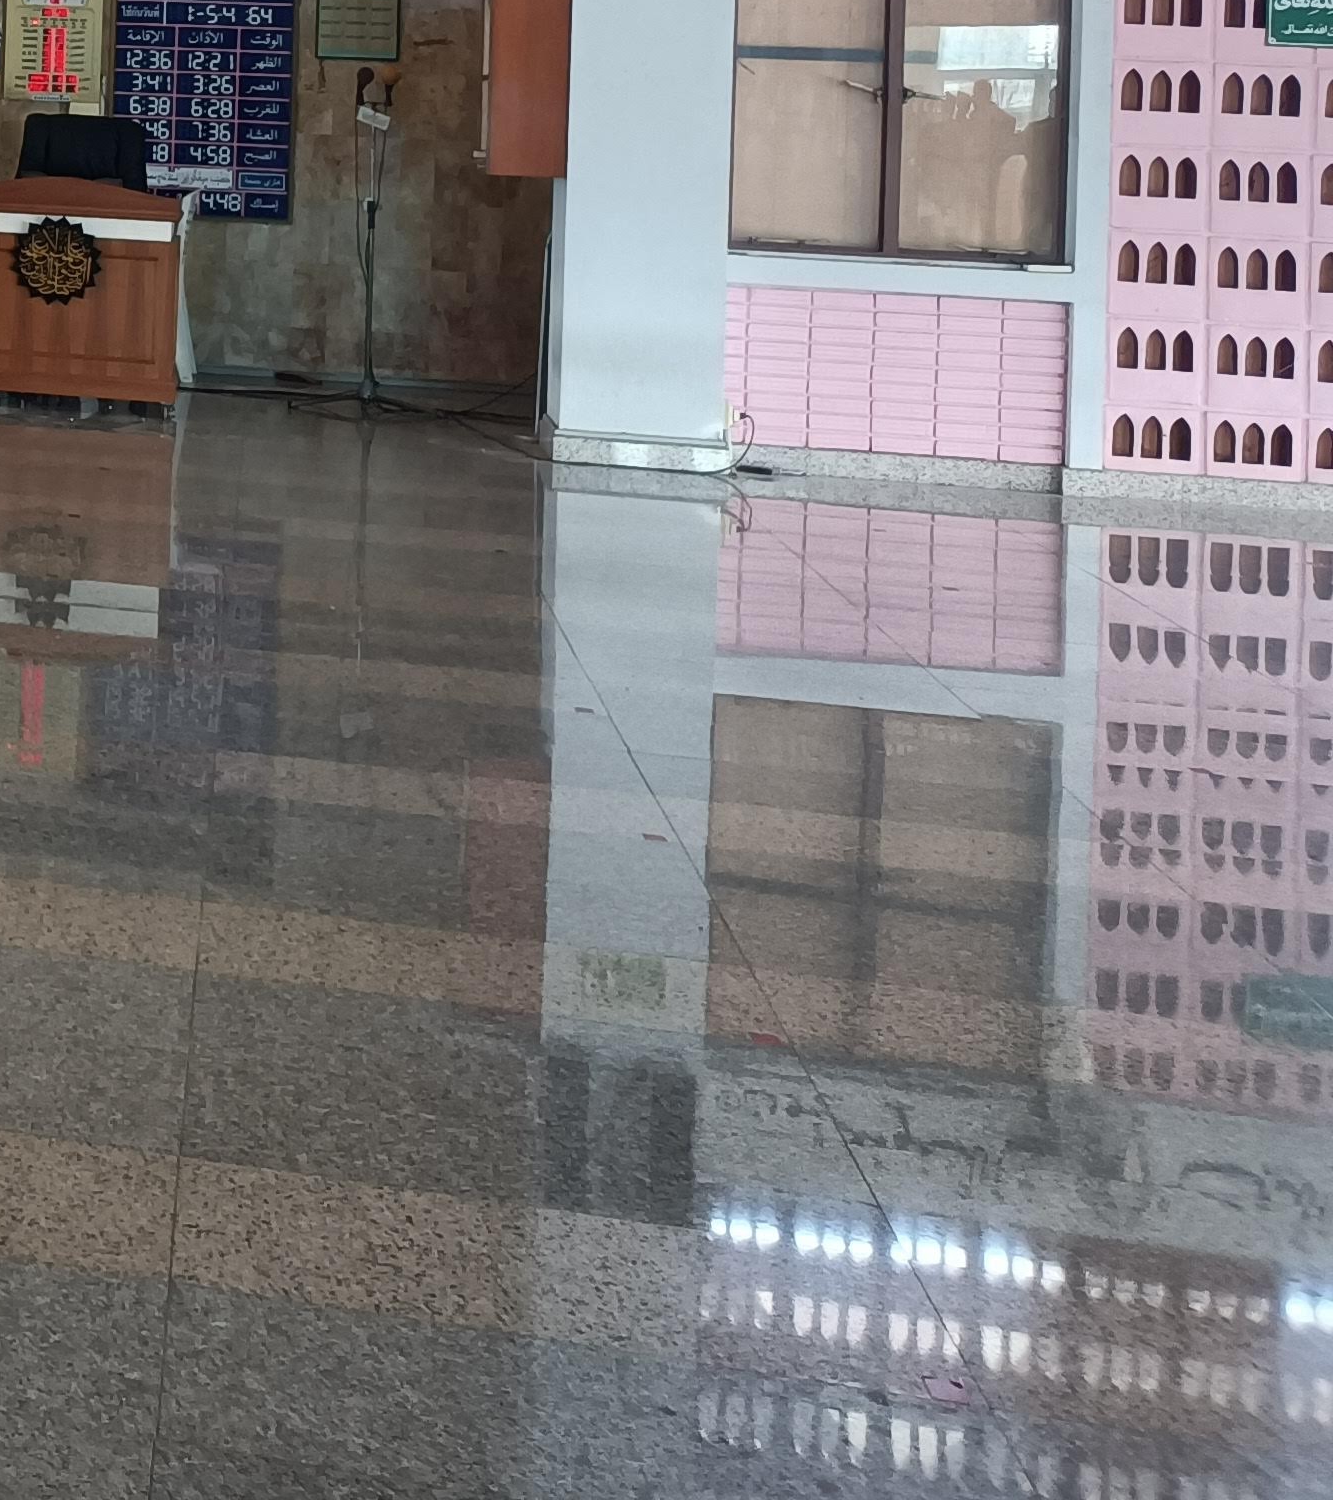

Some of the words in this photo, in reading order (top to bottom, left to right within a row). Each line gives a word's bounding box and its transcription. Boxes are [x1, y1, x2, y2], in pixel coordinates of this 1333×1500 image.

[126, 50, 172, 70] 12:36
[188, 51, 234, 71] 12:21
[193, 74, 234, 95] 3:26
[129, 95, 171, 116] 6:38
[190, 98, 233, 118] 6:28
[191, 121, 231, 142] 7:36
[189, 145, 231, 165] 4:58
